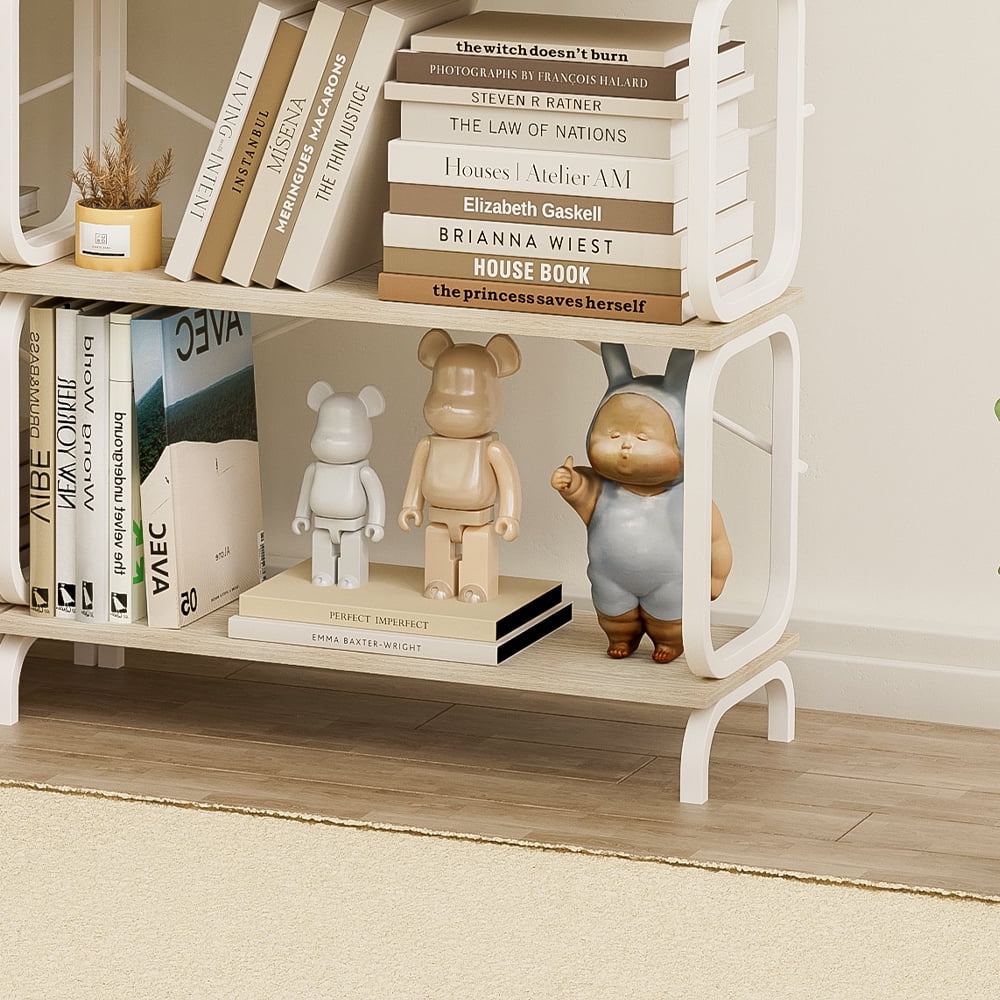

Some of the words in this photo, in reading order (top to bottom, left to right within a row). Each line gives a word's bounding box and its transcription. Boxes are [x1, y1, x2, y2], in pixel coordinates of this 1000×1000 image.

[430, 64, 518, 80] PHOTOGRAPHS
[521, 71, 534, 81] BY
[538, 71, 597, 86] FRANÇOIS
[600, 75, 648, 88] HALARD
[219, 70, 253, 137] LIVING
[339, 81, 370, 139] JUSTICE
[472, 91, 525, 106] STEVEN
[531, 96, 540, 107] R
[547, 97, 602, 111] RATNER
[275, 144, 314, 234] MERINGUES
[311, 53, 347, 142] MACARONS
[450, 117, 482, 133] THE
[489, 120, 521, 136] LAW
[528, 123, 548, 136] OF
[556, 126, 627, 143] NATIONS
[231, 110, 269, 194] INSTANBUL
[326, 140, 344, 174] THIN
[445, 156, 510, 181] Houses
[526, 163, 590, 186] Atelier
[594, 169, 631, 189] AM
[190, 152, 224, 222] INTENT
[316, 175, 337, 202] THE
[464, 197, 537, 217] Elizabeth
[542, 202, 601, 222] Gaskell
[440, 227, 538, 248] BRIANNA
[550, 236, 613, 254] WIEST
[474, 257, 534, 280] HOUSE
[540, 263, 590, 285] BOOK
[433, 284, 461, 298] the
[464, 286, 536, 305] princess
[537, 293, 583, 308] saves
[586, 296, 646, 313] herself
[330, 611, 370, 623] PERFECT
[375, 617, 429, 629] IMPERFECT
[312, 634, 338, 643] EMMA
[343, 636, 422, 652] BAXTER-WRIGHT
